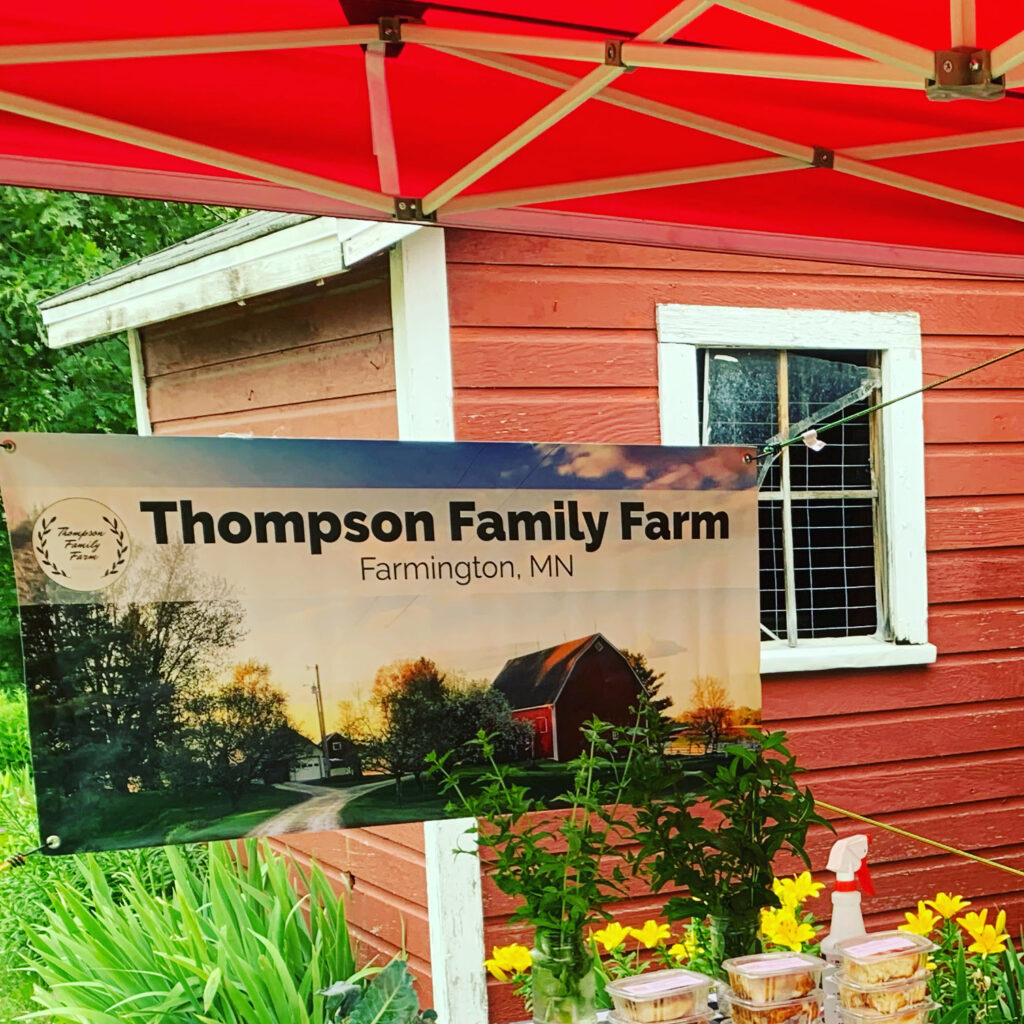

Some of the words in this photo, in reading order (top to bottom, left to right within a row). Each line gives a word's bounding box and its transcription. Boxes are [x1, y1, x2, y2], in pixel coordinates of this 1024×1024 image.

[57, 526, 105, 541] Thompson
[139, 499, 436, 555] Thompson
[449, 500, 609, 553] Family
[620, 501, 730, 540] Farm
[64, 539, 100, 553] Family
[69, 551, 98, 560] Farm
[360, 554, 521, 586] Farmington,
[530, 554, 574, 578] MN
